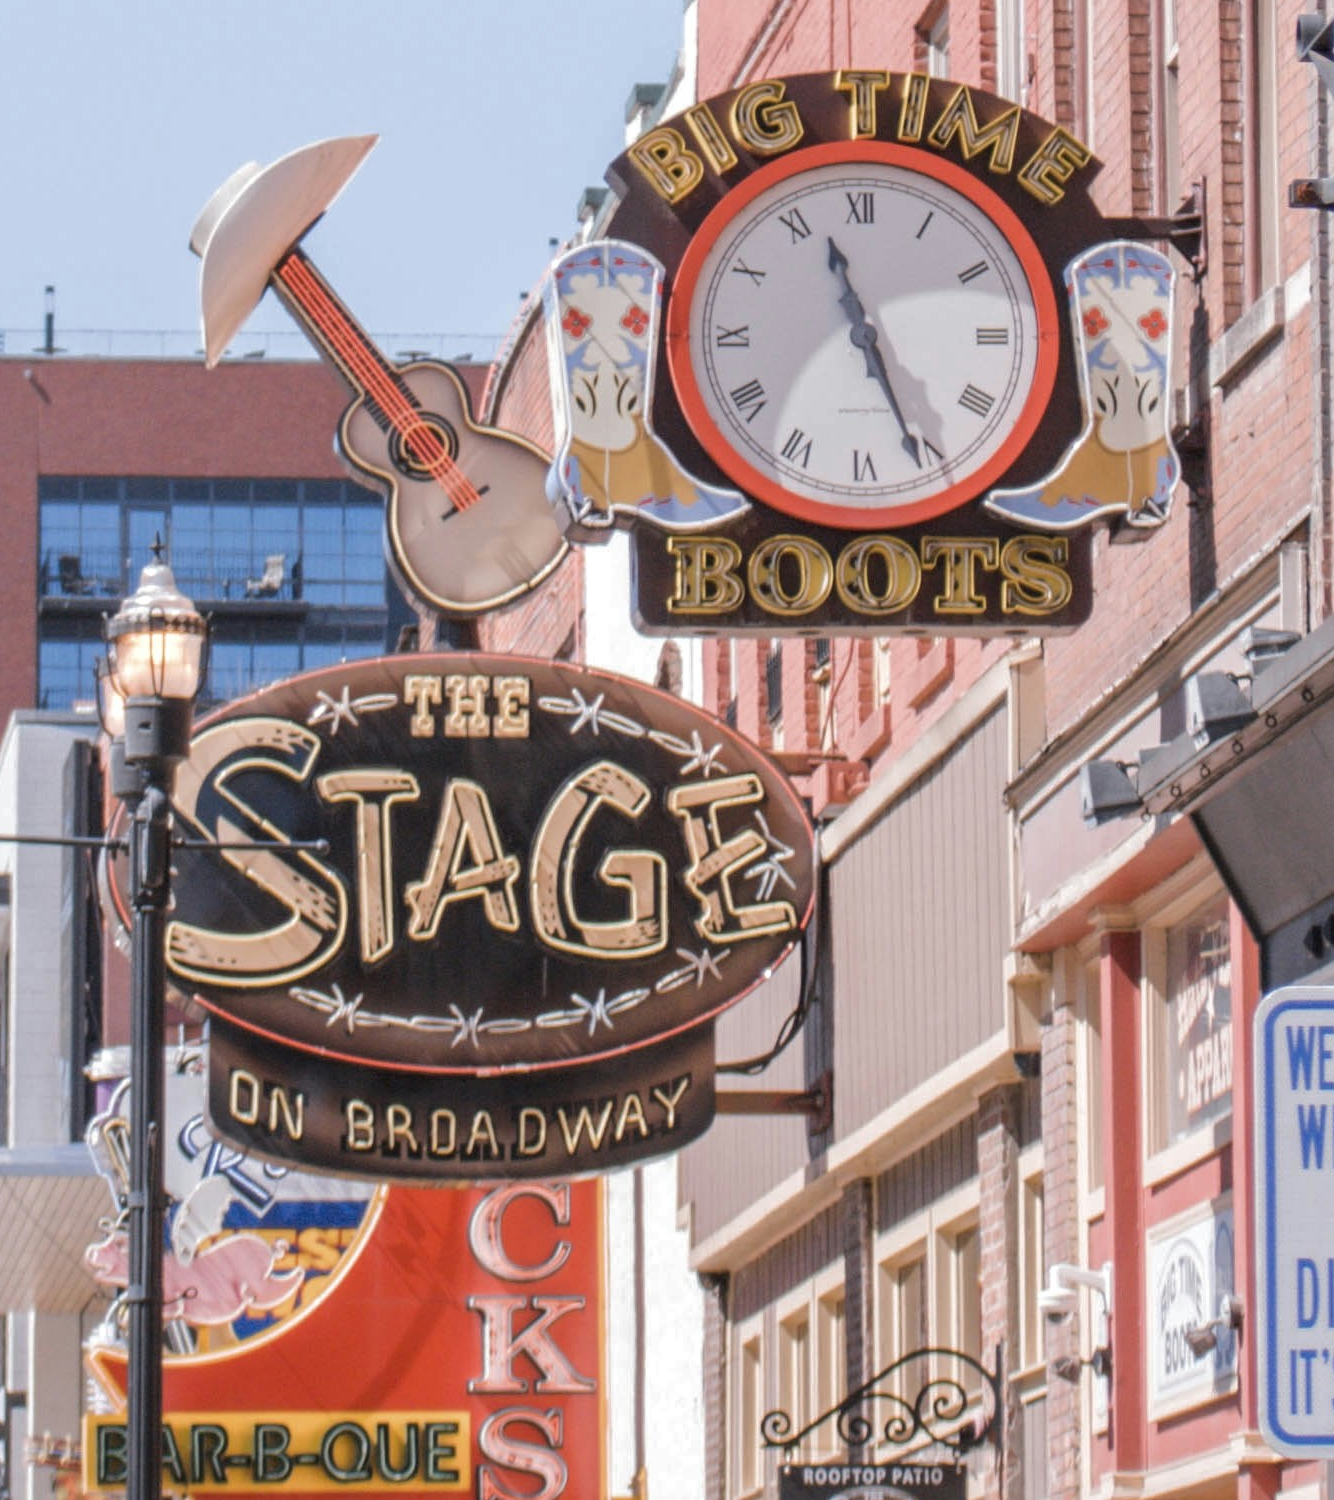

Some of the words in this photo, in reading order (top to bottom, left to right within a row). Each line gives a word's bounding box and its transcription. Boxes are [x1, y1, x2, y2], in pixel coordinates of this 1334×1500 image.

[627, 78, 805, 205] BIG
[834, 69, 1094, 205] TIME
[666, 533, 1073, 618] BOOTS
[403, 674, 532, 738] THE
[165, 717, 797, 988] STAGE
[229, 1068, 305, 1141] ON
[345, 1078, 691, 1157] BROADWAY
[803, 1467, 887, 1486] ROOFTOP
[892, 1467, 944, 1486] PATIO
